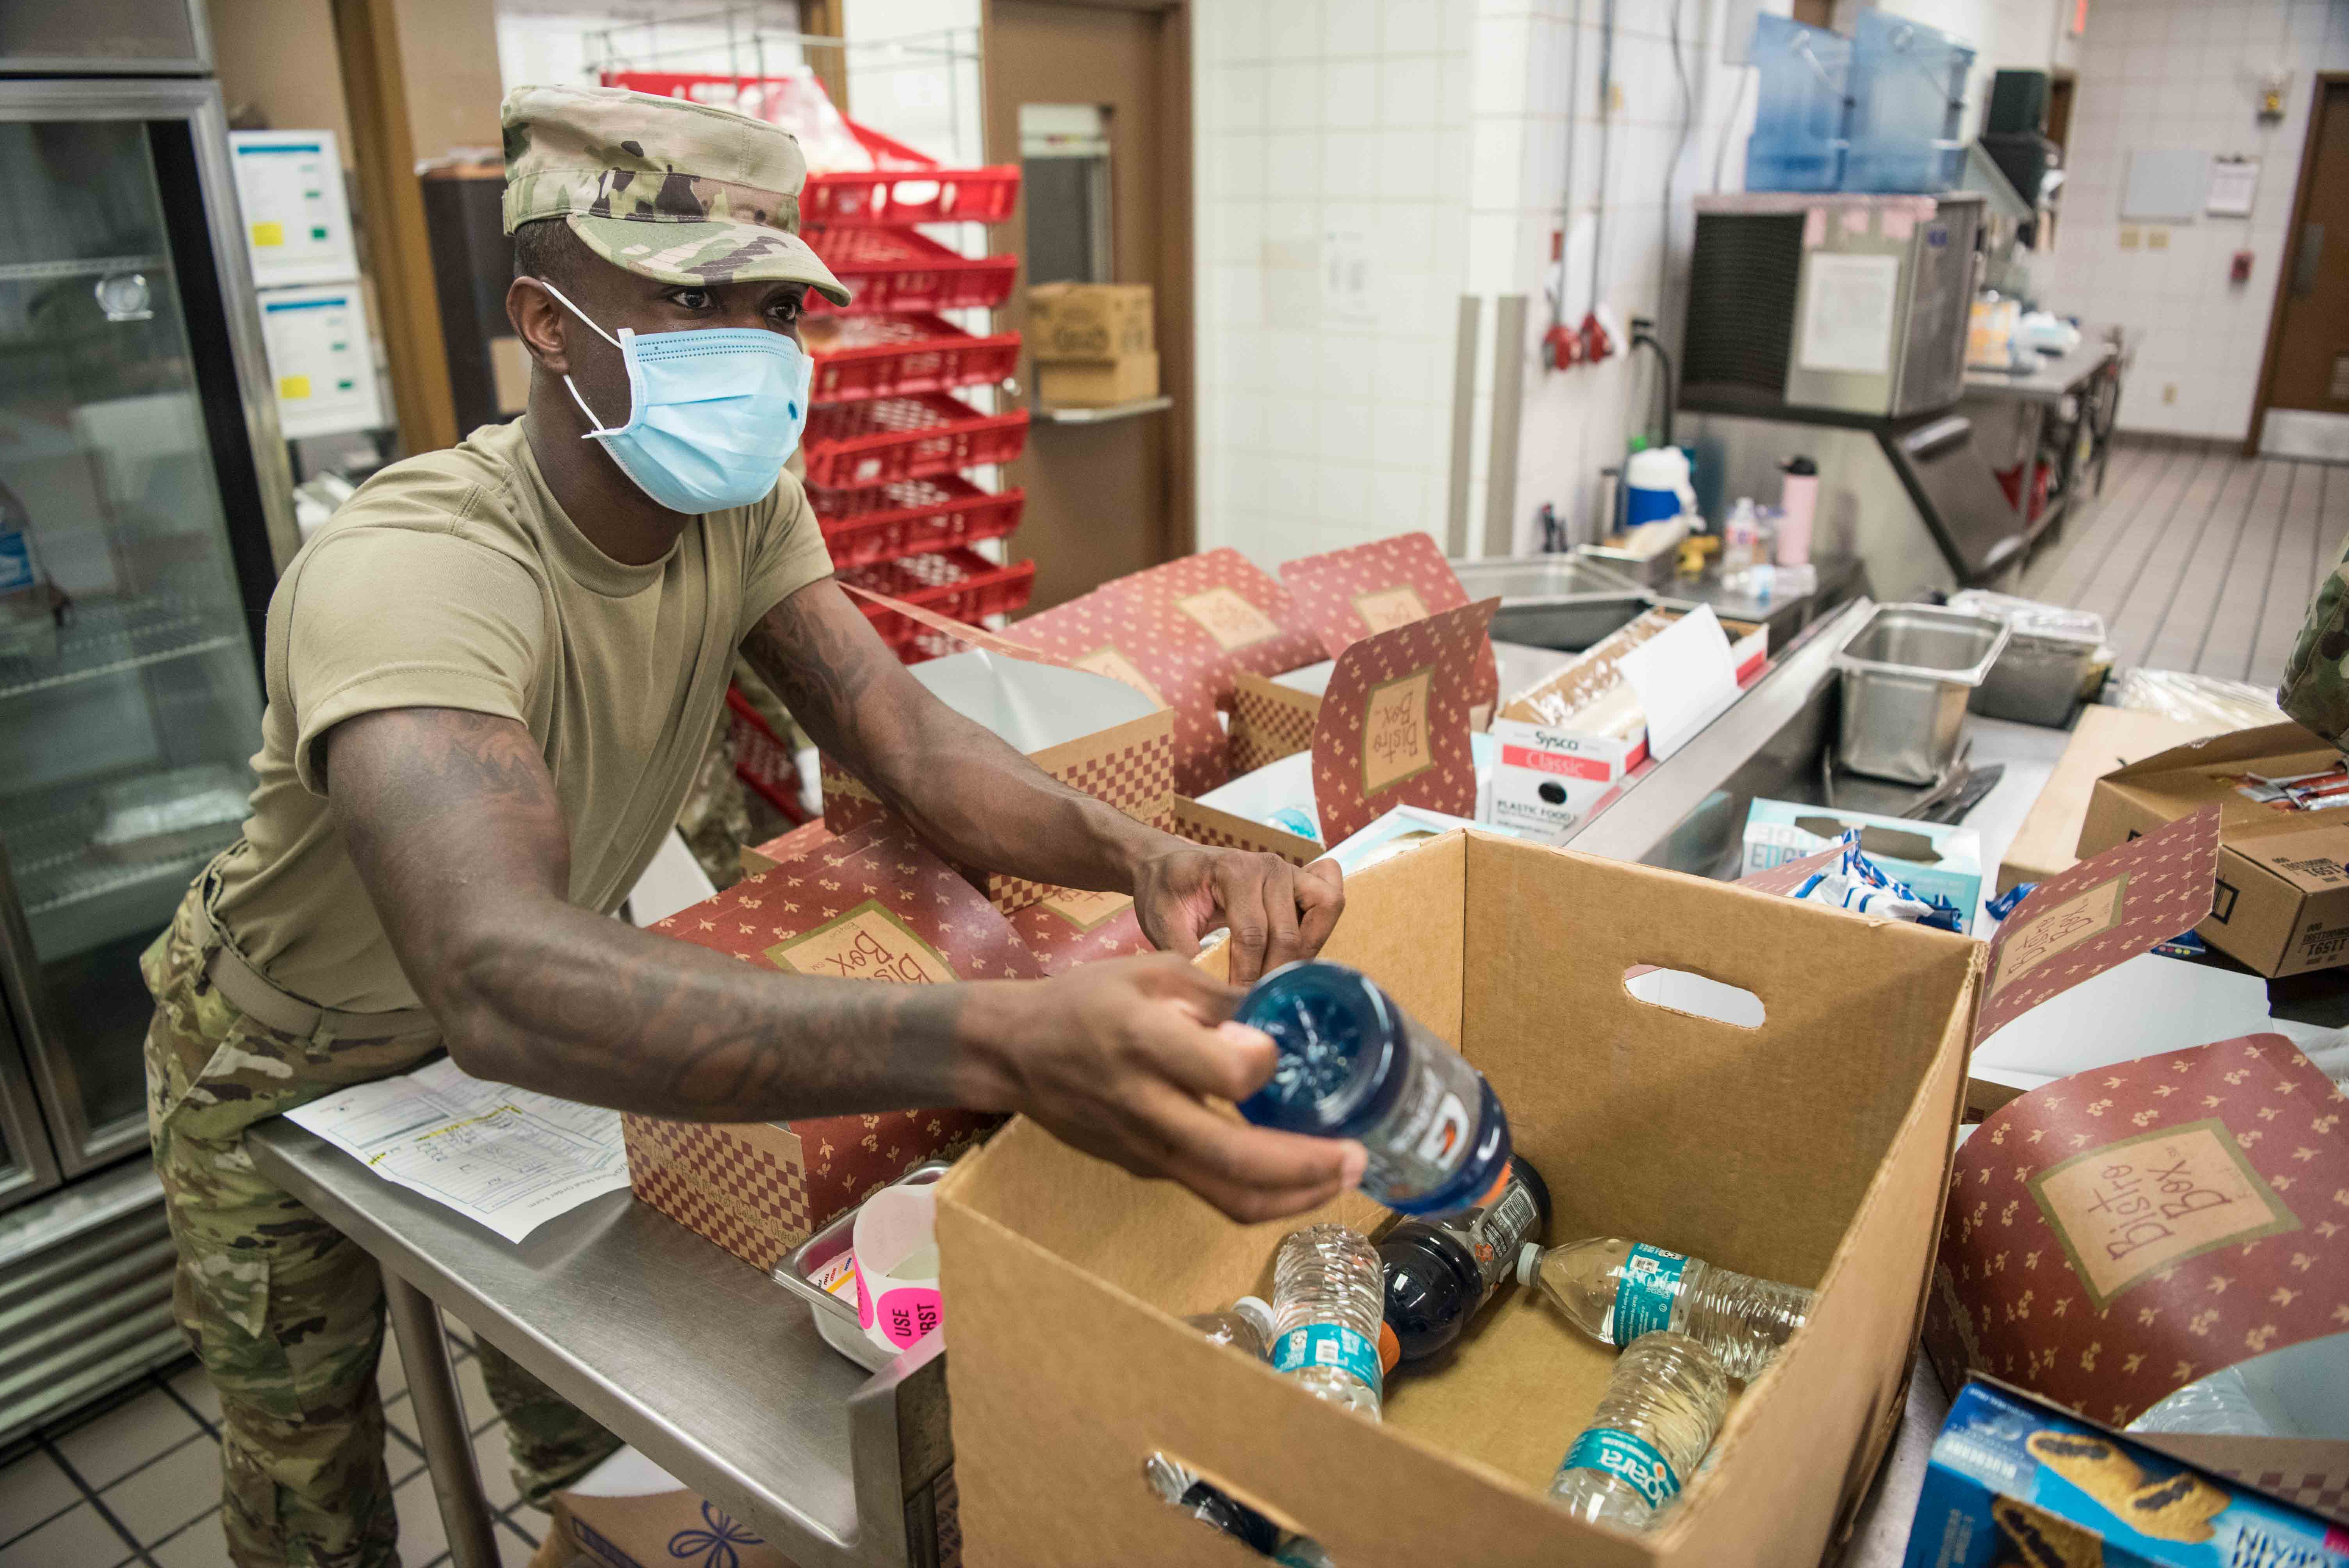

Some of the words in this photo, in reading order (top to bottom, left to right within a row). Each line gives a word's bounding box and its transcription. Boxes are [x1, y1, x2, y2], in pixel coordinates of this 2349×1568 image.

[1382, 690, 1413, 728] Box
[1373, 722, 1418, 764] Bistro
[1535, 731, 1578, 750] Sysco
[1526, 750, 1584, 777] Classic
[1497, 800, 1536, 814] PLASTIC
[1541, 808, 1570, 820] FOOD
[2049, 903, 2094, 944] Box
[825, 930, 894, 976] Box
[2006, 916, 2055, 976] Bistro
[2147, 1159, 2233, 1220] Box
[2087, 1164, 2175, 1261] Bistro
[771, 1217, 809, 1245] Chocol
[844, 1257, 852, 1271] MON
[892, 1308, 912, 1337] USE
[917, 1303, 937, 1335] RST
